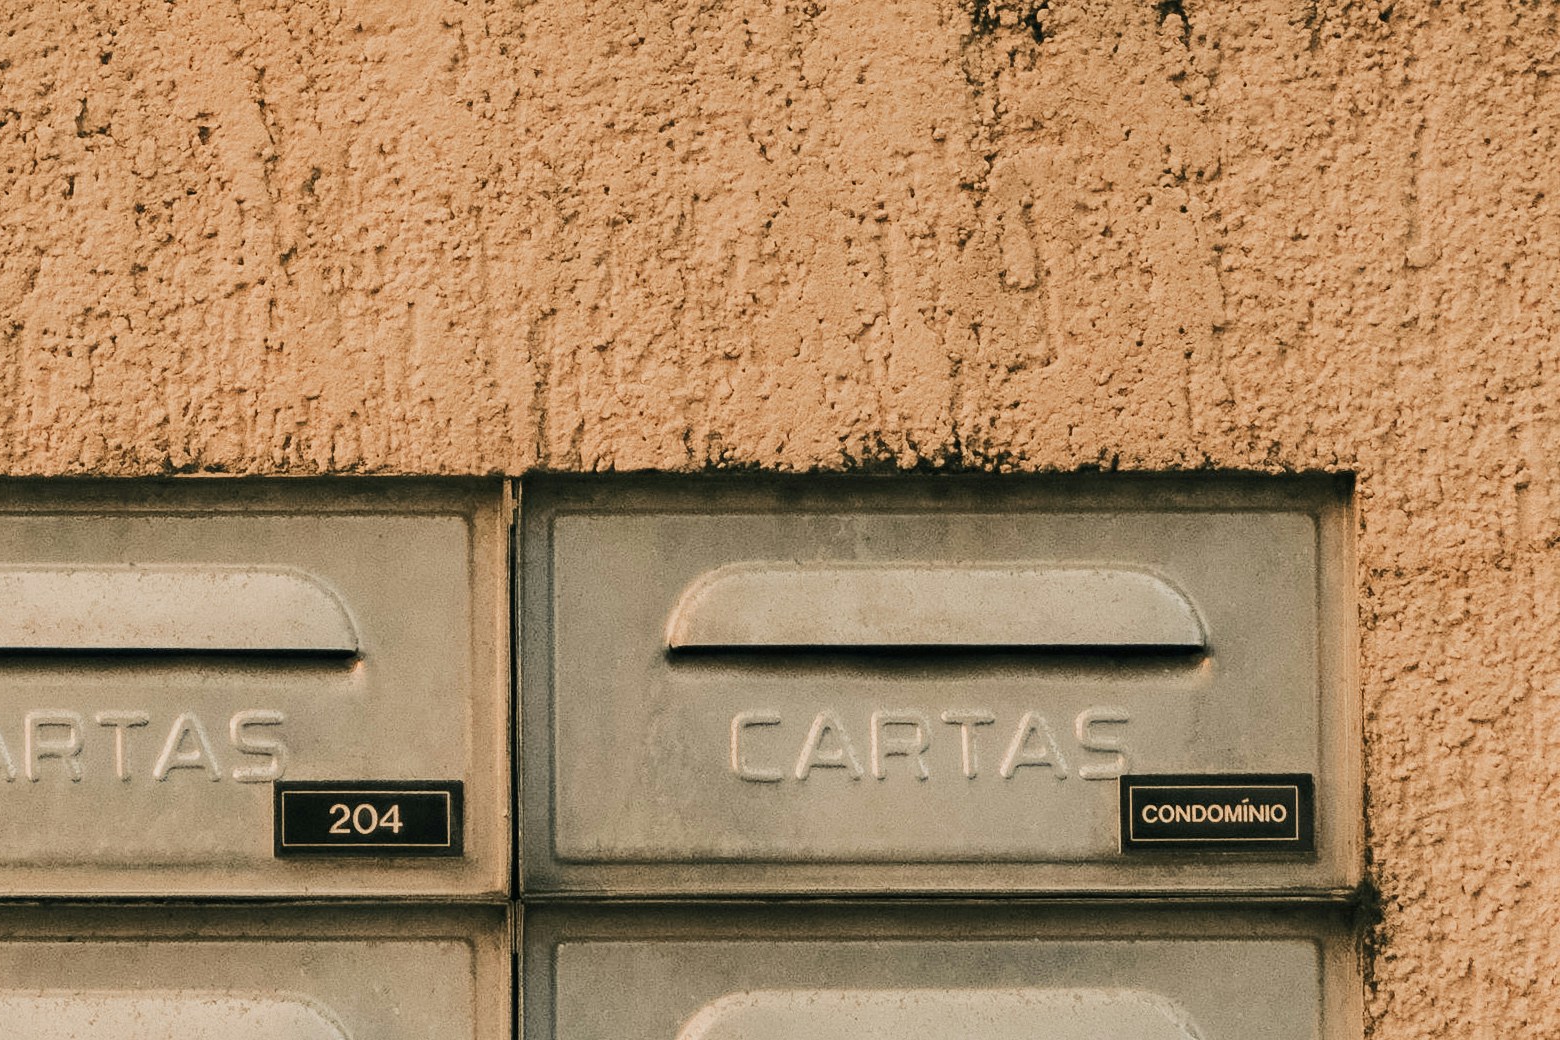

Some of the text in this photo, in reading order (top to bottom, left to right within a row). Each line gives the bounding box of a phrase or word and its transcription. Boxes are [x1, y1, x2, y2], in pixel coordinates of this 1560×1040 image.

[732, 705, 1131, 782] CARTAS
[328, 803, 404, 835] 204
[1141, 797, 1287, 824] CONDOMÍNIO
